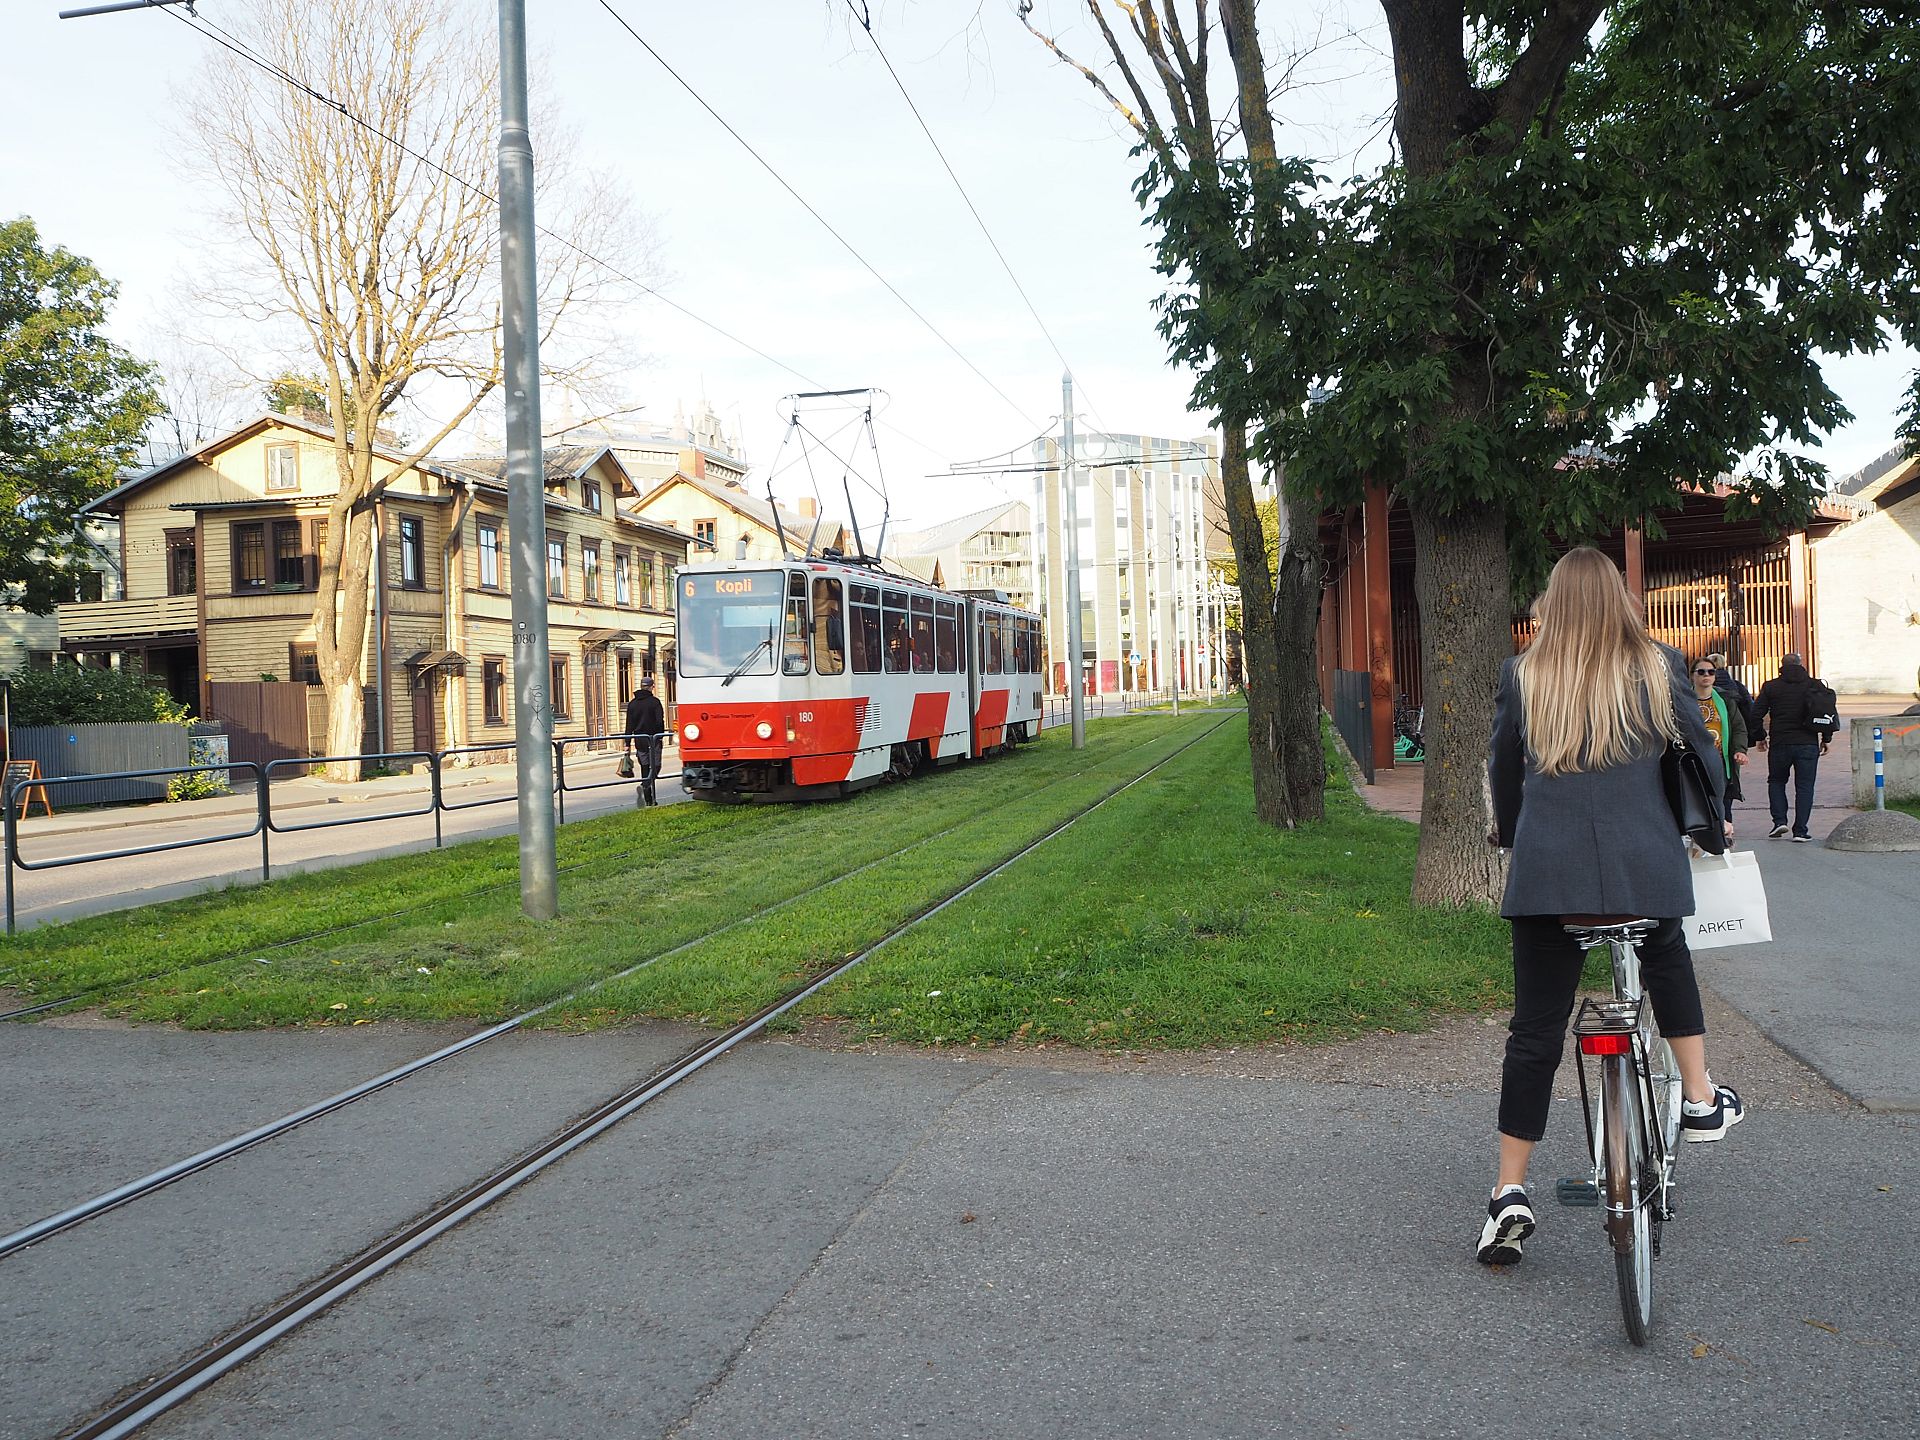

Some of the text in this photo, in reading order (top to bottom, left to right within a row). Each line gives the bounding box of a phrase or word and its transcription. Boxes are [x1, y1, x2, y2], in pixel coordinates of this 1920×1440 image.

[685, 578, 752, 597] 6 Kopli
[798, 711, 814, 722] 180
[1698, 918, 1745, 934] ARKET
